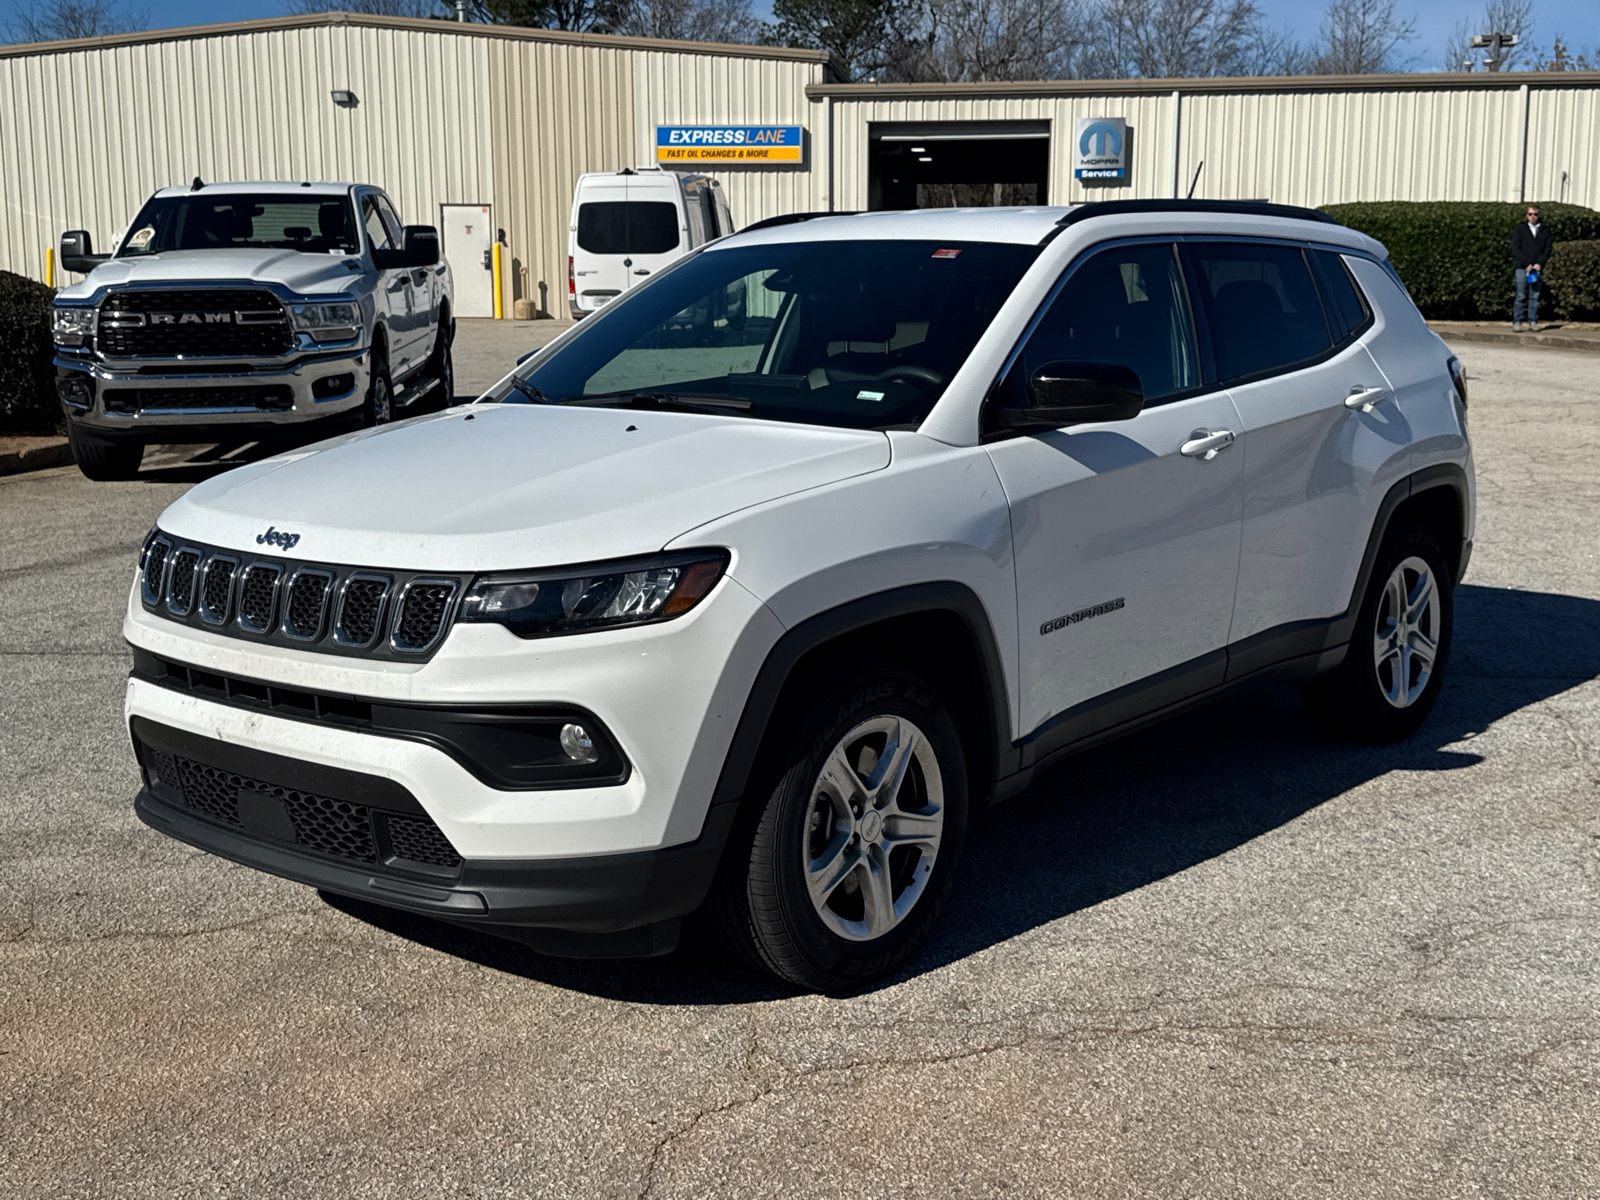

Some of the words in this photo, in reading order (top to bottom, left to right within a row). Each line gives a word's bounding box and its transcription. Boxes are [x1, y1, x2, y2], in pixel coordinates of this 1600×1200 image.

[666, 150, 686, 158] FAST
[687, 150, 699, 158] OIL
[701, 150, 737, 158] CHANGES
[737, 150, 745, 158] &
[746, 150, 769, 158] MORE
[1081, 169, 1118, 178] Service
[150, 311, 231, 325] RAM
[256, 525, 301, 552] Jeep
[1040, 596, 1126, 636] COMPASS
